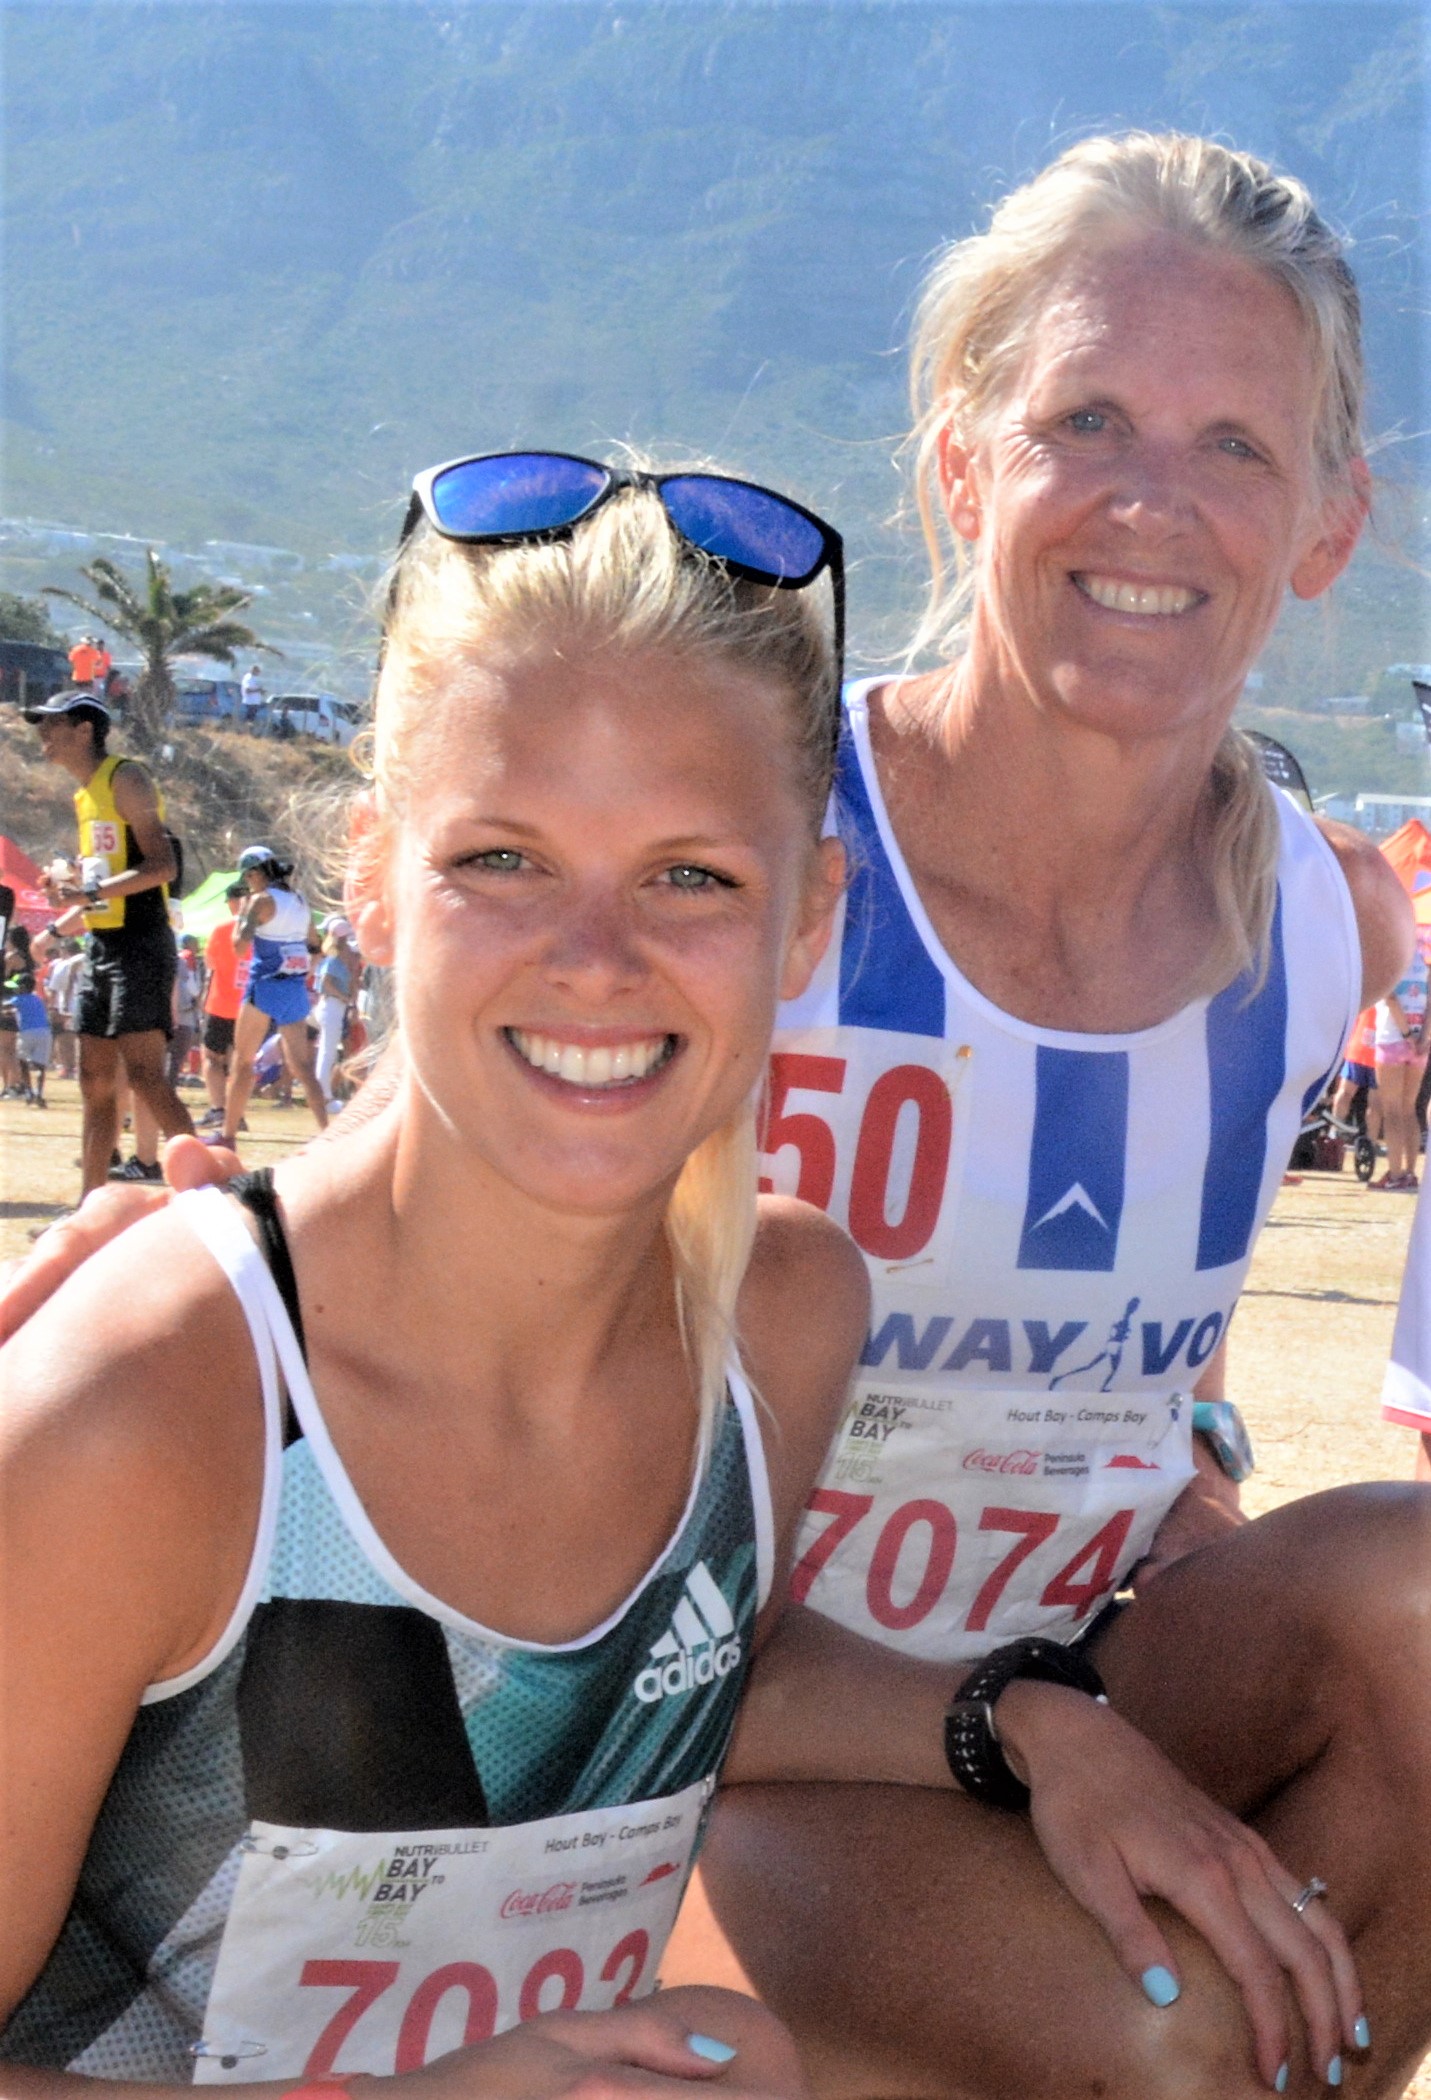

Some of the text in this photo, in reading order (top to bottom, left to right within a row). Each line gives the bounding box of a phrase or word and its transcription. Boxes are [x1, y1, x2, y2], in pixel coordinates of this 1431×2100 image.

[756, 1053, 953, 1260] 50
[861, 1402, 907, 1421] BAY
[1007, 1409, 1042, 1422] Hout
[1044, 1409, 1067, 1425] Bay
[1077, 1408, 1120, 1424] Camps
[1122, 1410, 1148, 1425] Bay
[849, 1420, 896, 1441] BAY
[789, 1488, 1137, 1631] 7074
[634, 1636, 742, 1703] adidas
[545, 1835, 579, 1853] Hout
[582, 1832, 608, 1848] Bay
[618, 1821, 662, 1842] Camps
[394, 1840, 491, 1857] NUTRIBULLET
[386, 1857, 438, 1878] BAY
[432, 1875, 446, 1885] TO
[373, 1884, 428, 1902] BAY
